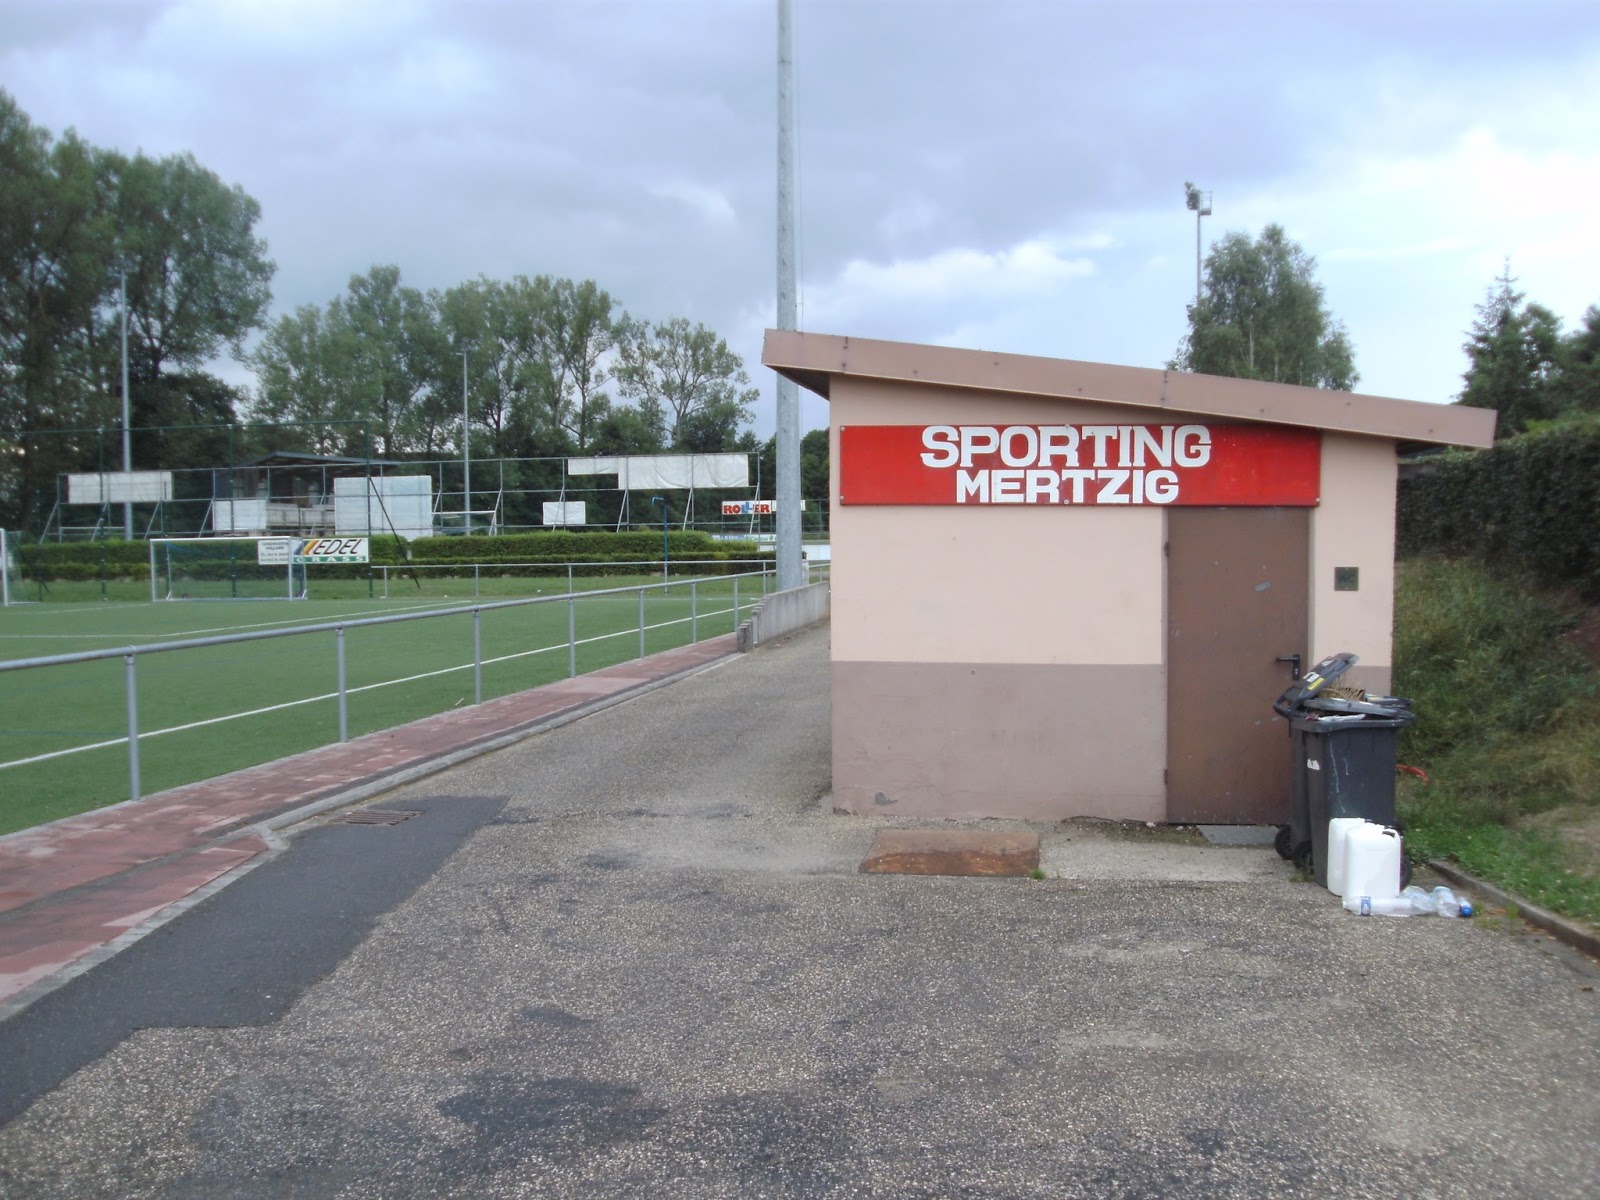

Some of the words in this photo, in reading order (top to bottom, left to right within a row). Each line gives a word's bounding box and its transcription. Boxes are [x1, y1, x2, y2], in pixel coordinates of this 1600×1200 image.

[920, 425, 1212, 468] SPORTING
[956, 469, 1179, 504] MERTZIG
[724, 502, 770, 514] ROLLER
[313, 539, 363, 555] EDEL
